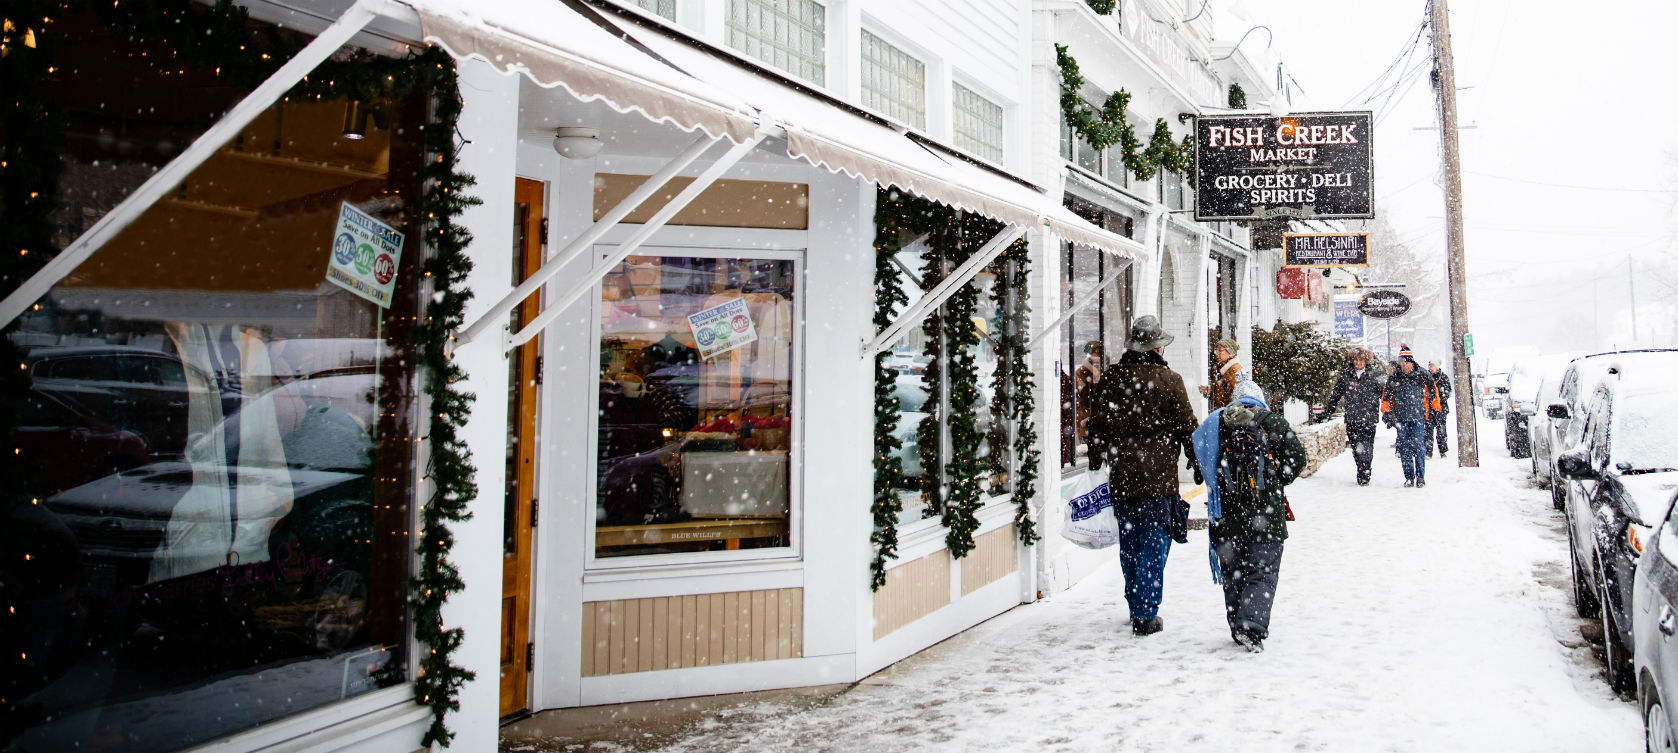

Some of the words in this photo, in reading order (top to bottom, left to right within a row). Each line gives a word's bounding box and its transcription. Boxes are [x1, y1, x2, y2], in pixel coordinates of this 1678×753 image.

[1208, 125, 1264, 147] FISH
[1276, 124, 1359, 146] CREEK
[1250, 147, 1317, 162] MARKET
[1215, 174, 1297, 190] GROCERY
[1311, 173, 1352, 188] DELI
[1250, 189, 1317, 204] SPIRITS
[1265, 207, 1288, 217] SINCE
[345, 208, 373, 231] WINTER
[381, 228, 400, 245] SALE
[344, 220, 359, 234] Save
[360, 232, 369, 240] on
[370, 234, 381, 246] All
[381, 241, 395, 254] Dots
[1314, 235, 1358, 250] HELSINKI
[1326, 248, 1333, 259] &
[1333, 249, 1346, 257] WINE
[1367, 296, 1400, 307] Bayside
[691, 310, 718, 323] WINTER
[726, 300, 743, 310] SALE
[695, 320, 709, 328] Save
[719, 312, 728, 320] All
[729, 308, 743, 316] Dots
